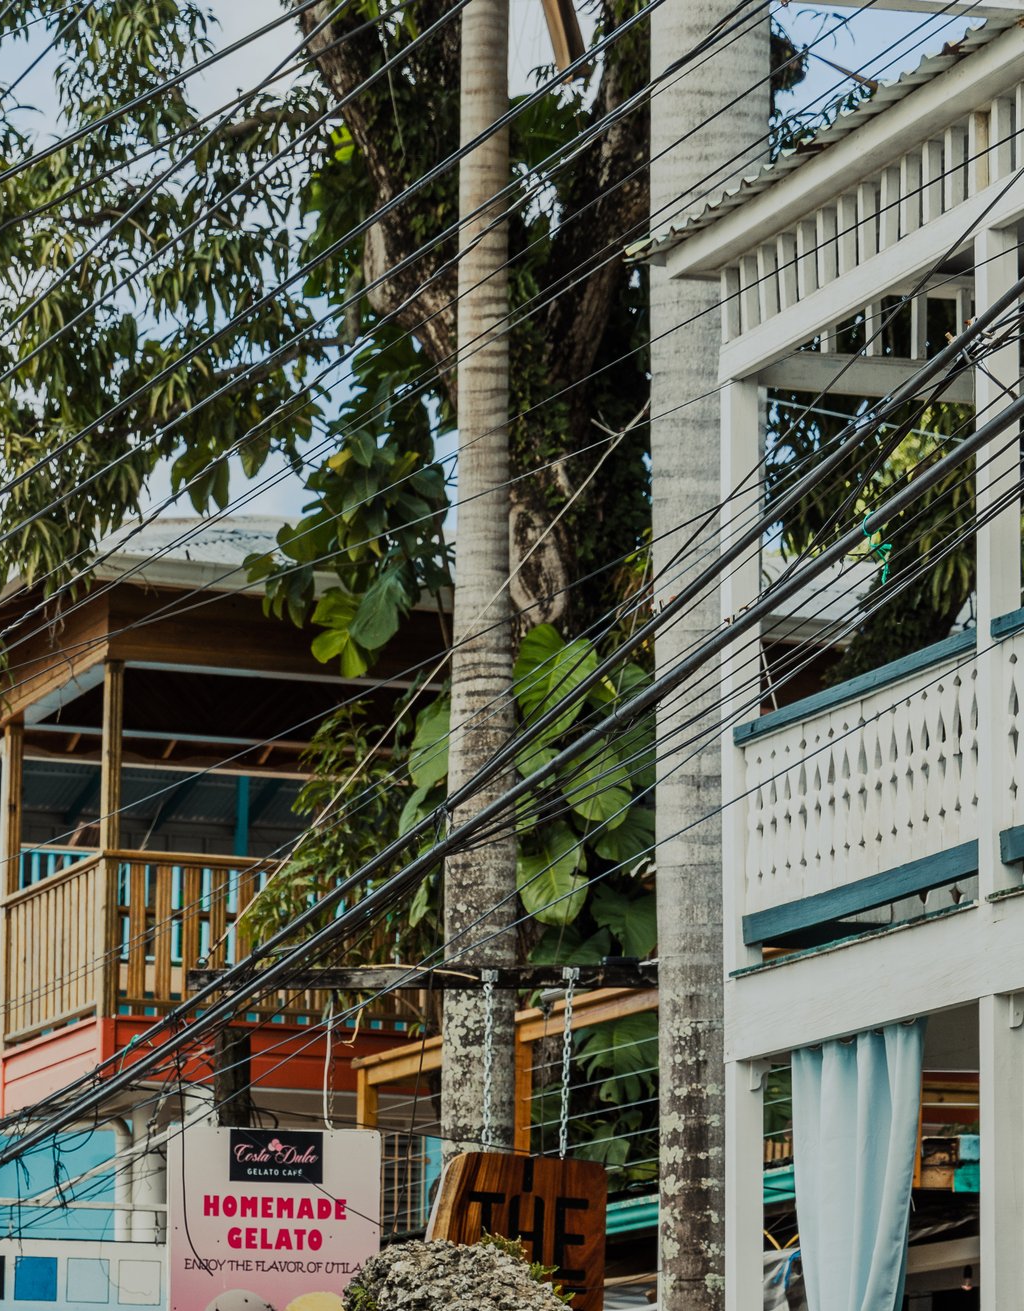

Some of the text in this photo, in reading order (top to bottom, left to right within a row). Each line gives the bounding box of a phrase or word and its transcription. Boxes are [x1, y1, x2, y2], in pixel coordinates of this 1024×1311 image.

[233, 1143, 319, 1164] Costa Dulce
[246, 1167, 280, 1177] GELATO
[203, 1194, 347, 1220] HOMEMADE
[227, 1226, 323, 1251] GELATO
[468, 1189, 589, 1282] THE
[184, 1257, 363, 1275] ENJOY THE FLAVOR OF UTILA
